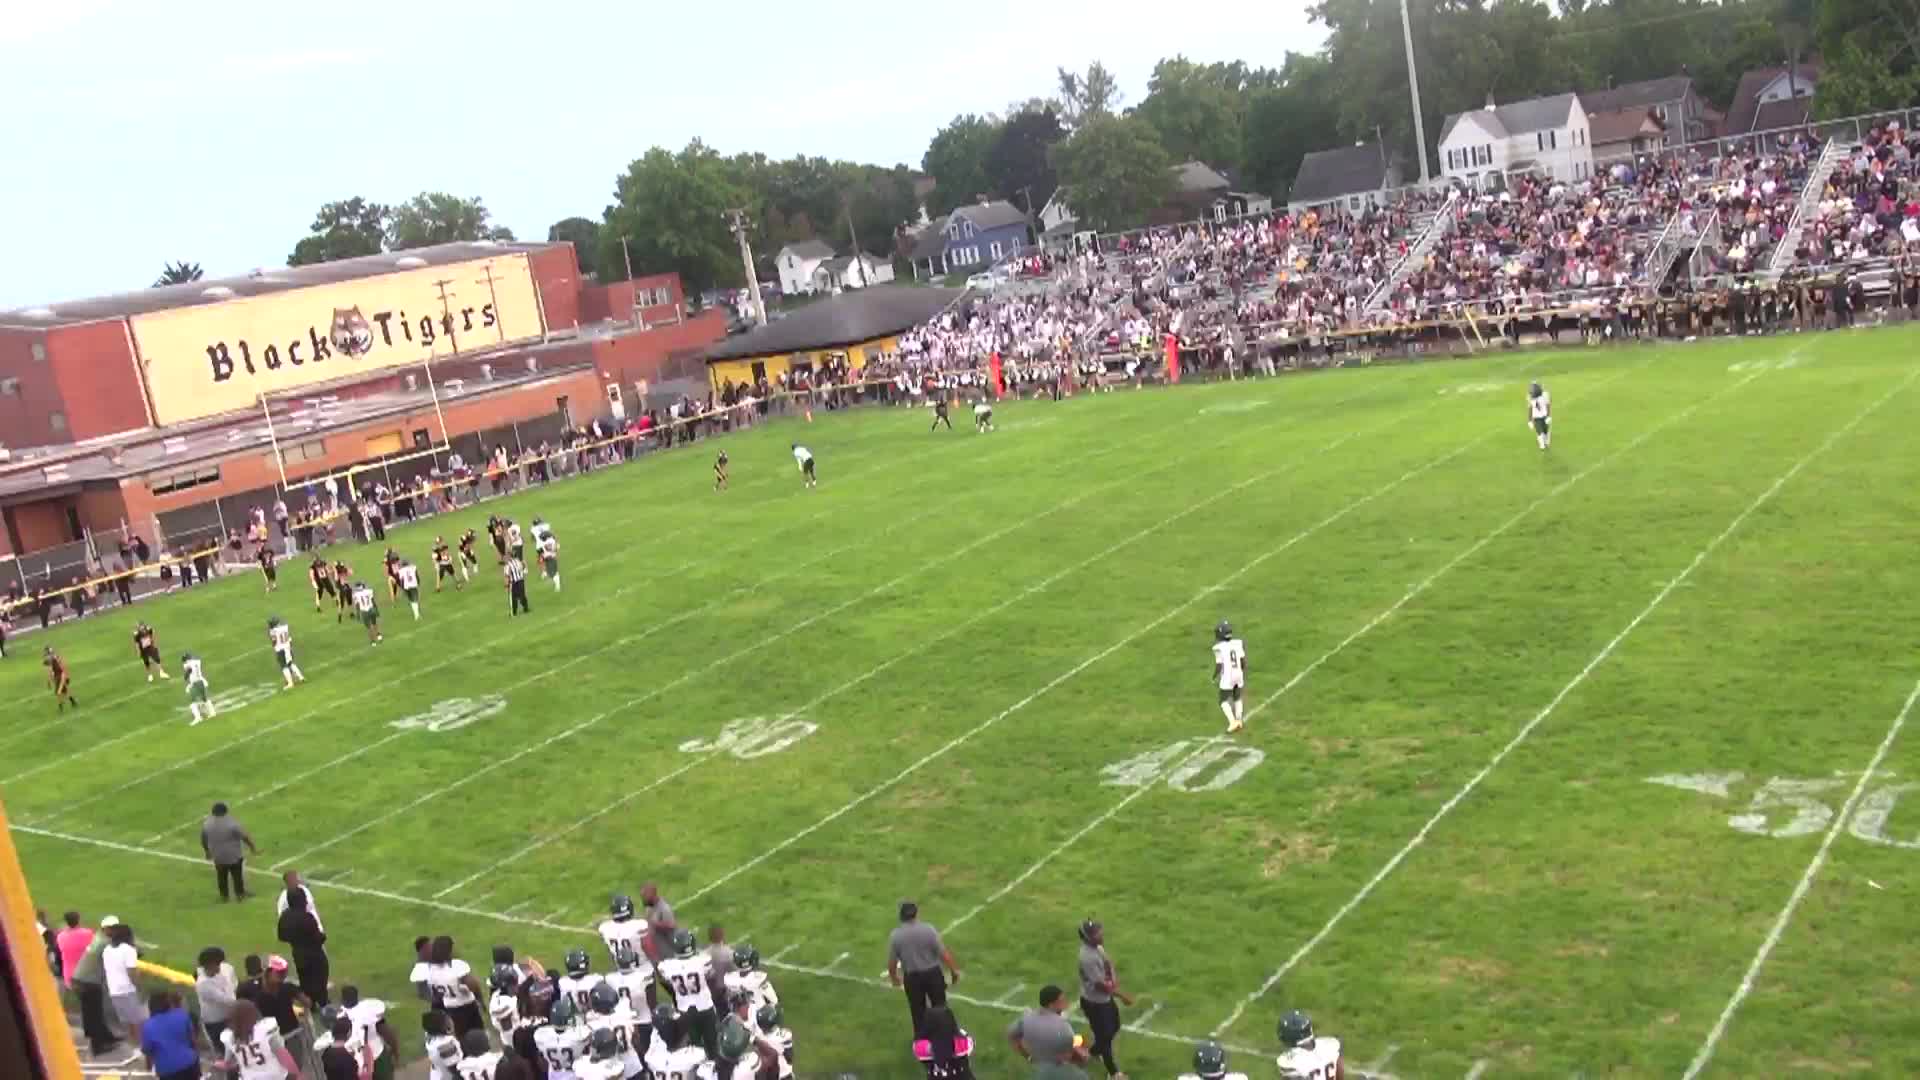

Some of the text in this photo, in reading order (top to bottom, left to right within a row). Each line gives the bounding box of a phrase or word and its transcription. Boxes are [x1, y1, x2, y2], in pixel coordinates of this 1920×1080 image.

[206, 303, 496, 382] Black Tigers
[1230, 650, 1238, 668] 9
[671, 972, 701, 996] 33
